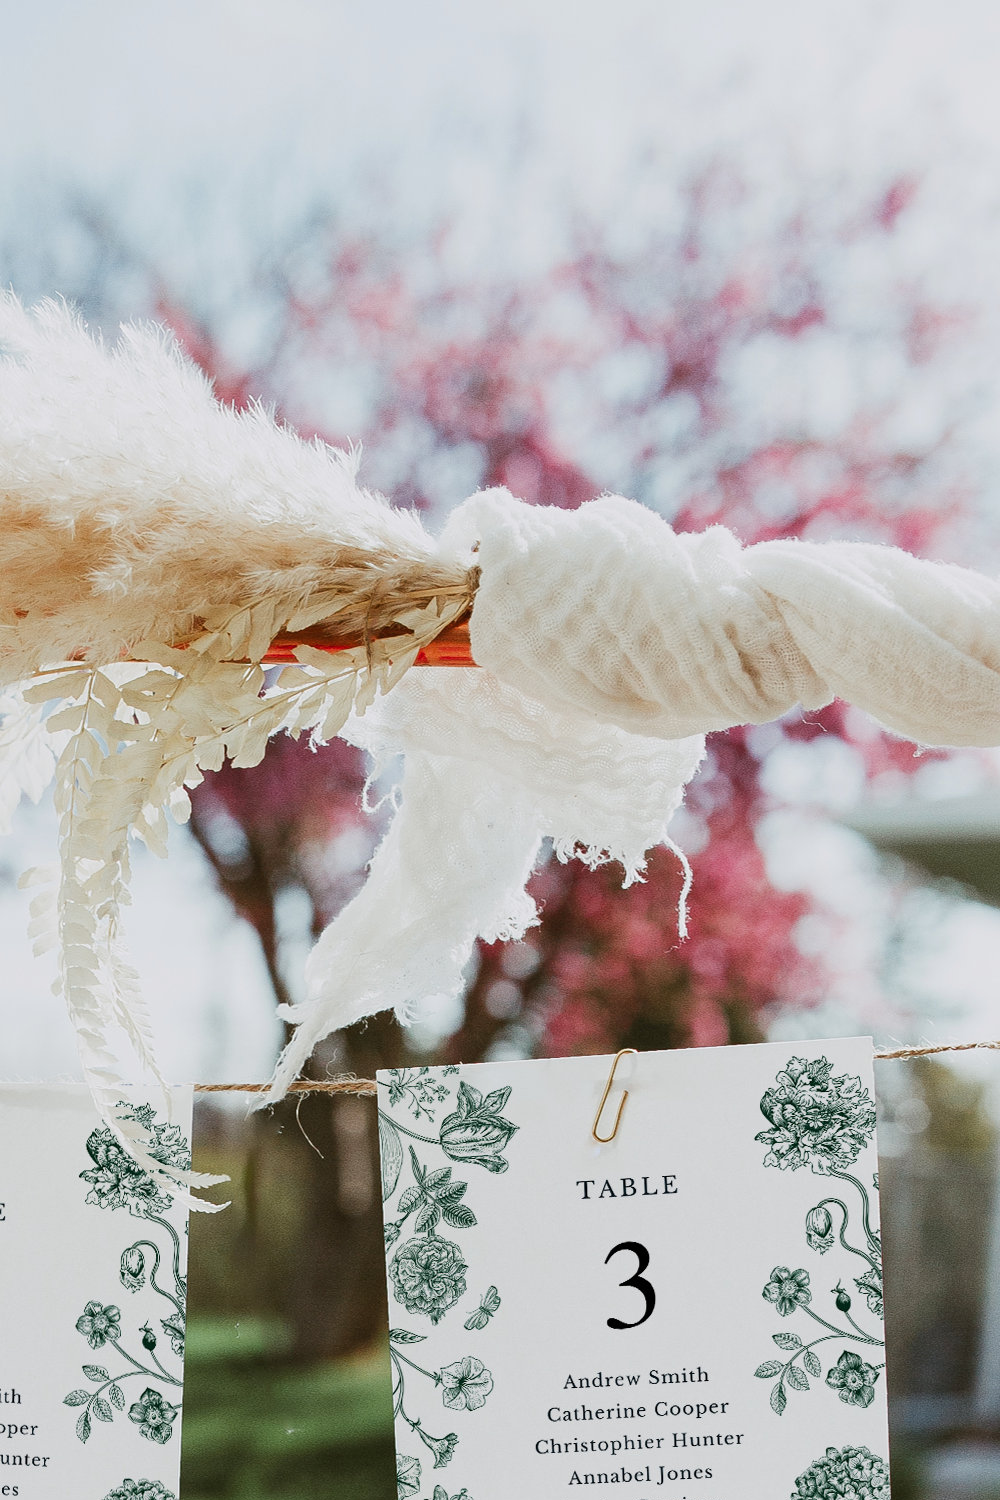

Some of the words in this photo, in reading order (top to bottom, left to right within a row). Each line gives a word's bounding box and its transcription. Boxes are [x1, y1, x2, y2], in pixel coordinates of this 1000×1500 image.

[575, 1174, 679, 1200] TABLE
[603, 1240, 657, 1331] 3
[562, 1371, 641, 1390] Andrew
[648, 1366, 710, 1385] Smith
[547, 1402, 647, 1423] Catherine
[654, 1401, 730, 1419] Cooper
[534, 1434, 665, 1456] Christophier
[671, 1432, 745, 1448] Hunter
[567, 1465, 652, 1486] Annabel
[656, 1465, 713, 1486] Jones
